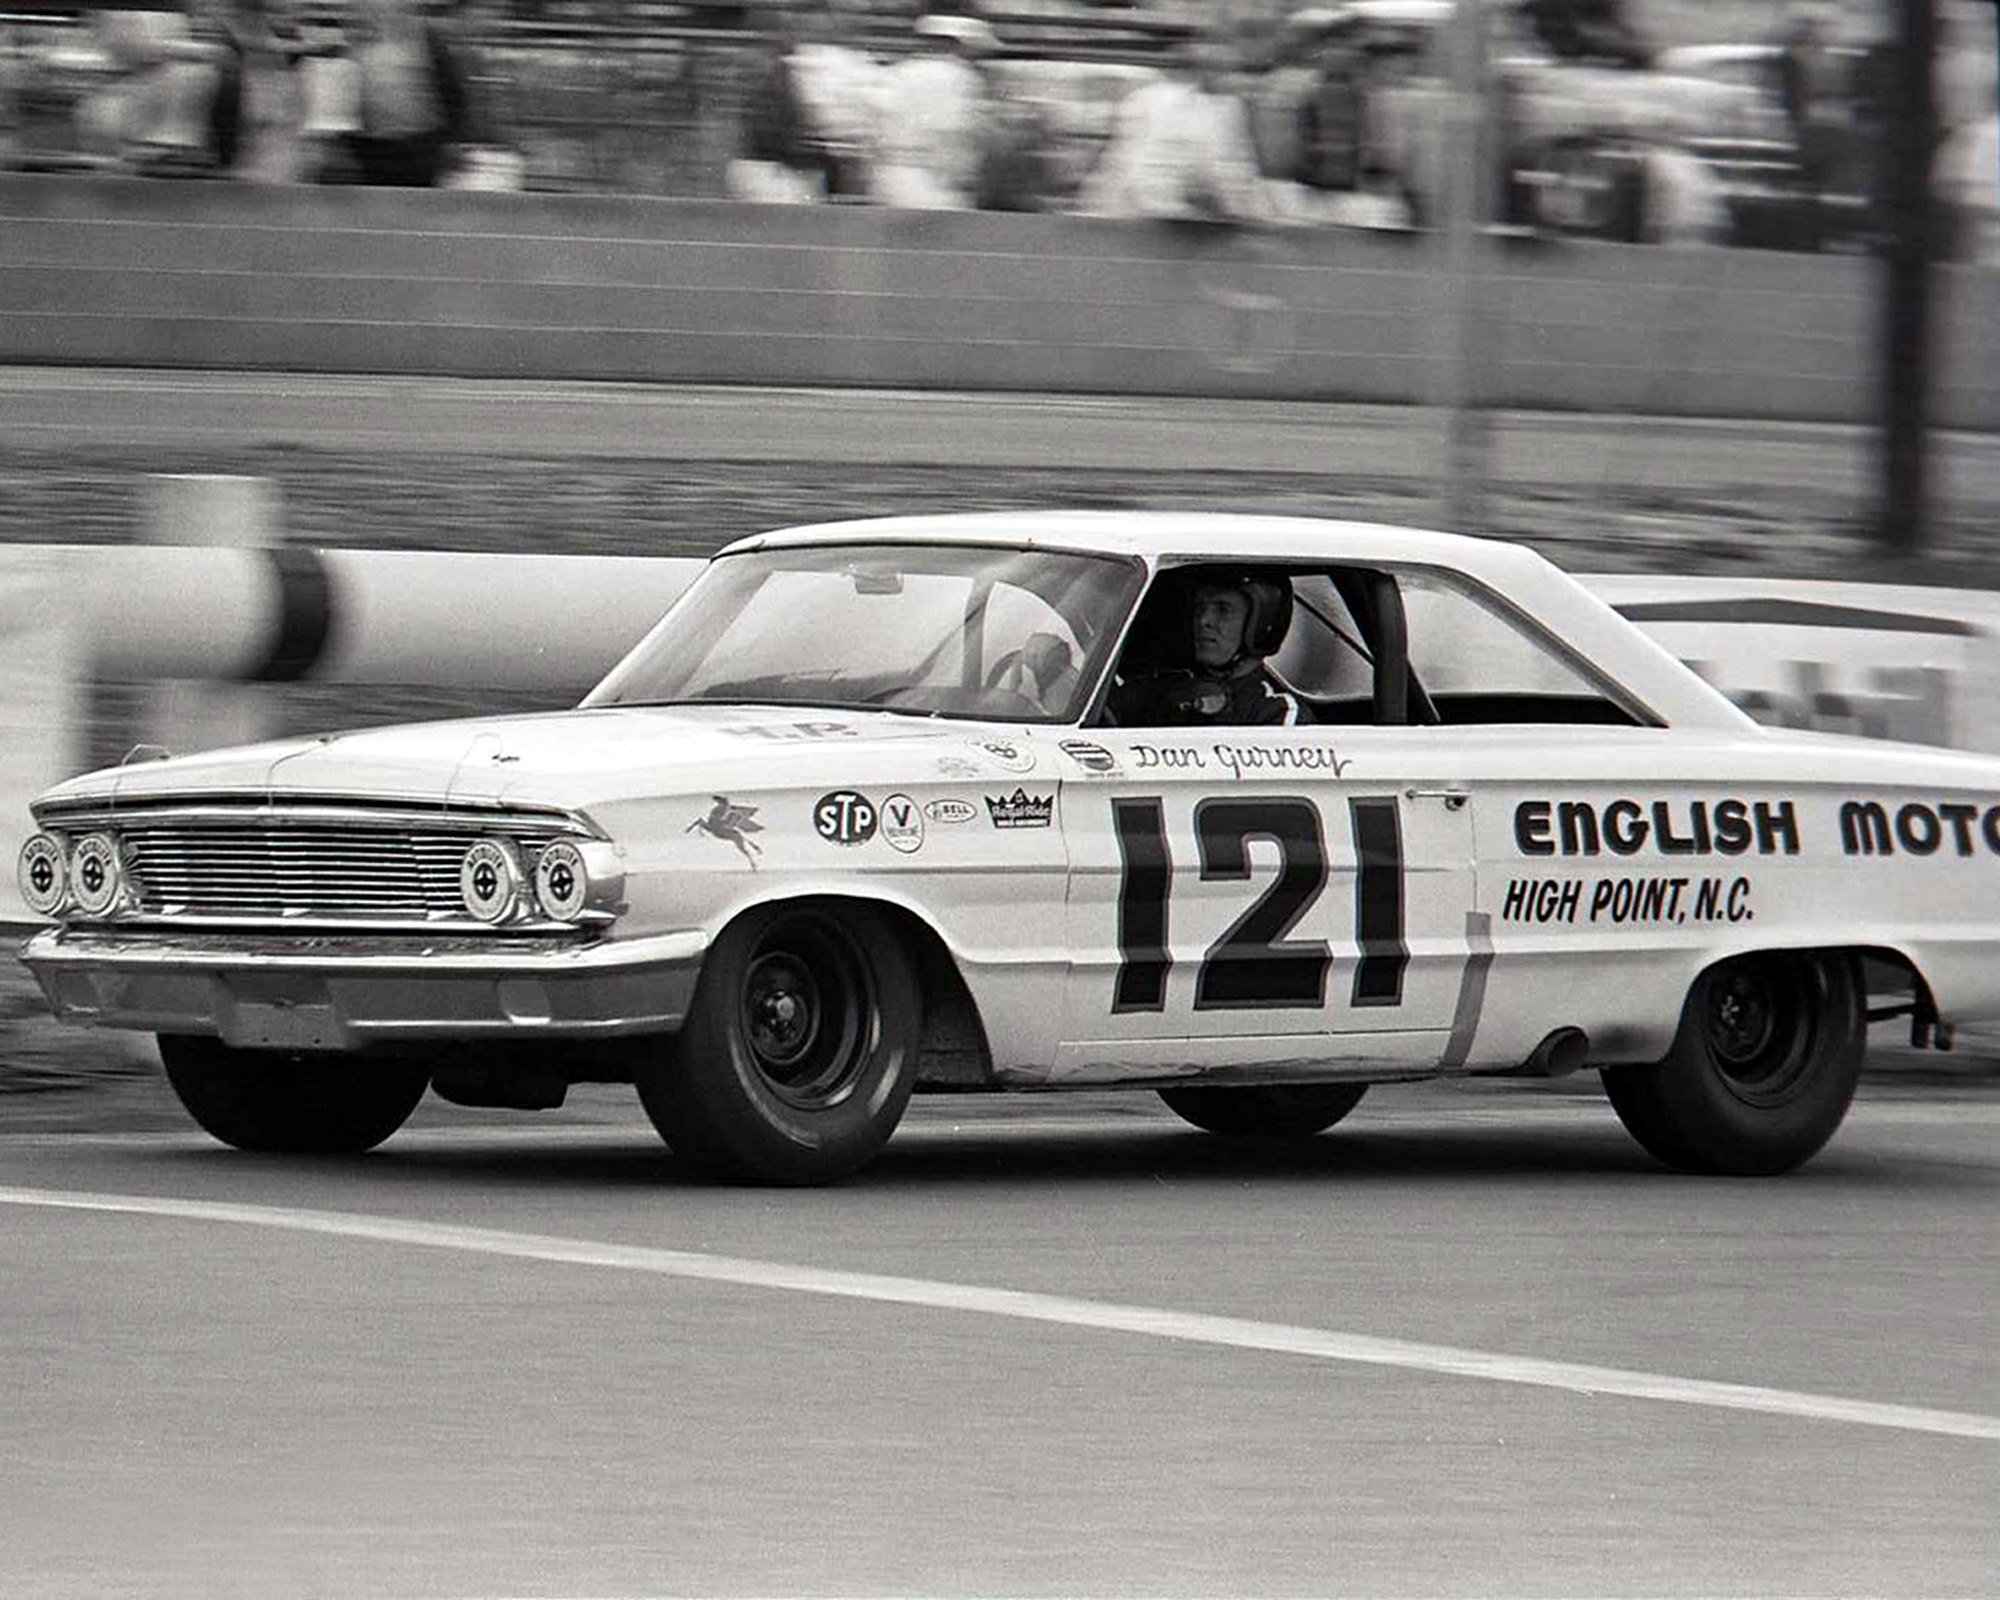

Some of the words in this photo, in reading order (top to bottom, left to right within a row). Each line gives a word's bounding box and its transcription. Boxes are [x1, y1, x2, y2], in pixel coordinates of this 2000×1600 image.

[1130, 745, 1206, 769] Dan
[1214, 745, 1353, 779] Gurney
[819, 794, 872, 839] STP
[890, 804, 911, 827] V
[1514, 799, 1801, 856] ENGLISH
[1111, 795, 1411, 1015] 121
[1502, 879, 1582, 922] HIGH
[1590, 877, 1689, 925] POINT,
[1694, 876, 1754, 921] N.C.
